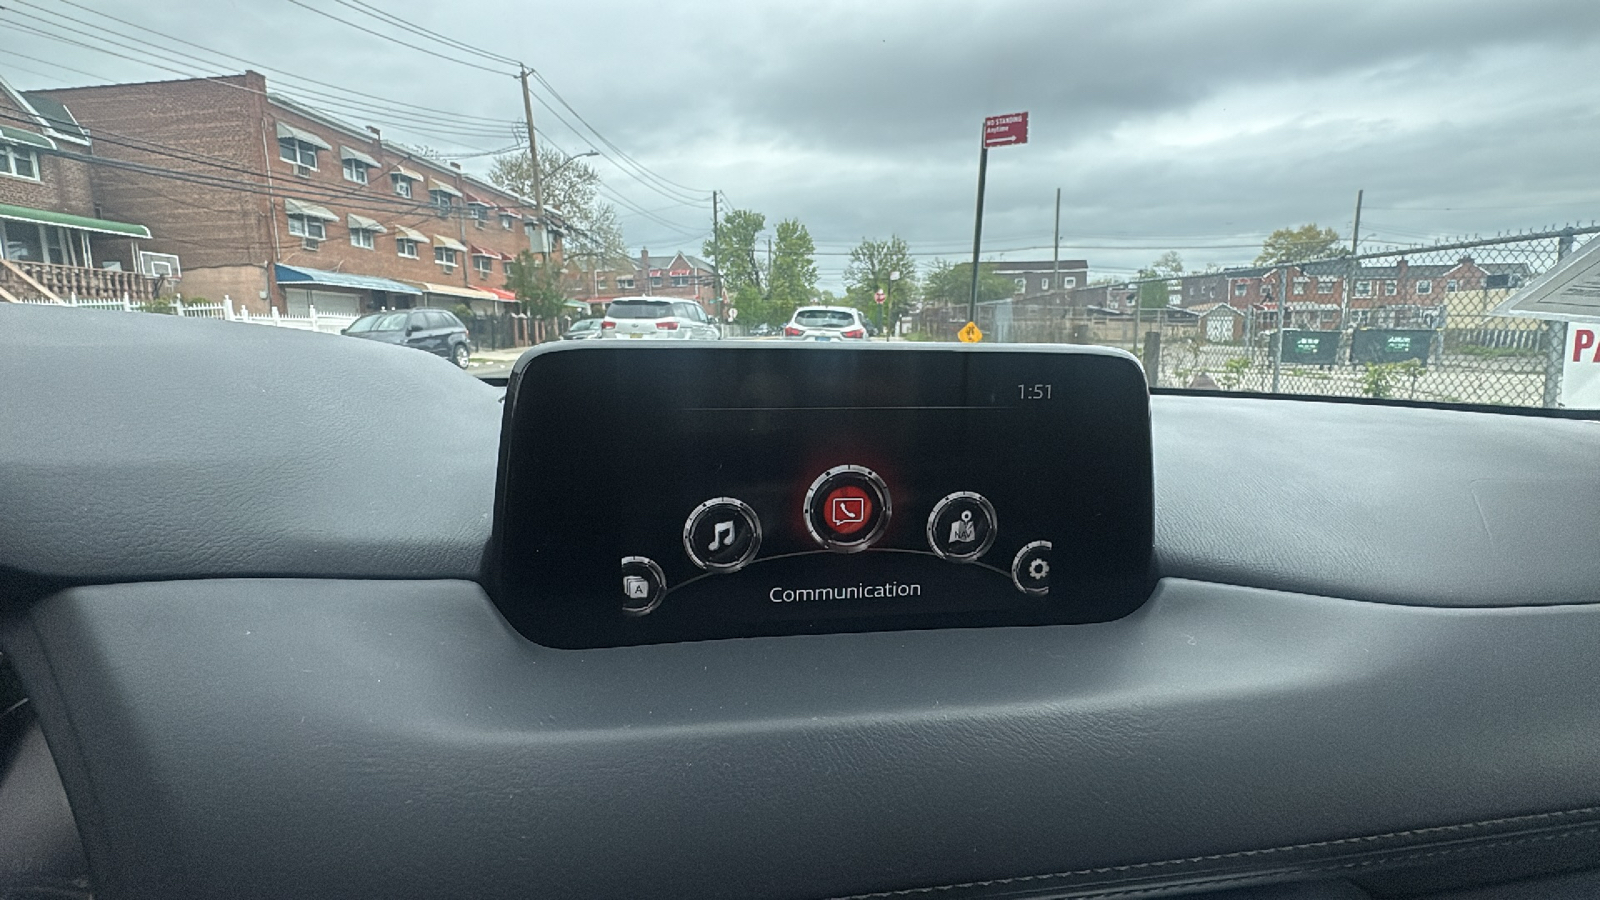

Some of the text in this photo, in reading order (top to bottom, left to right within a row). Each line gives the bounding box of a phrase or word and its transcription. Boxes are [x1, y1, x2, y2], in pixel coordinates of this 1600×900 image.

[995, 115, 1023, 126] STANDING
[986, 126, 1009, 134] Anytime
[1017, 384, 1052, 400] 1:51
[954, 530, 972, 540] NAV
[634, 584, 644, 594] A
[769, 581, 921, 603] Communication
